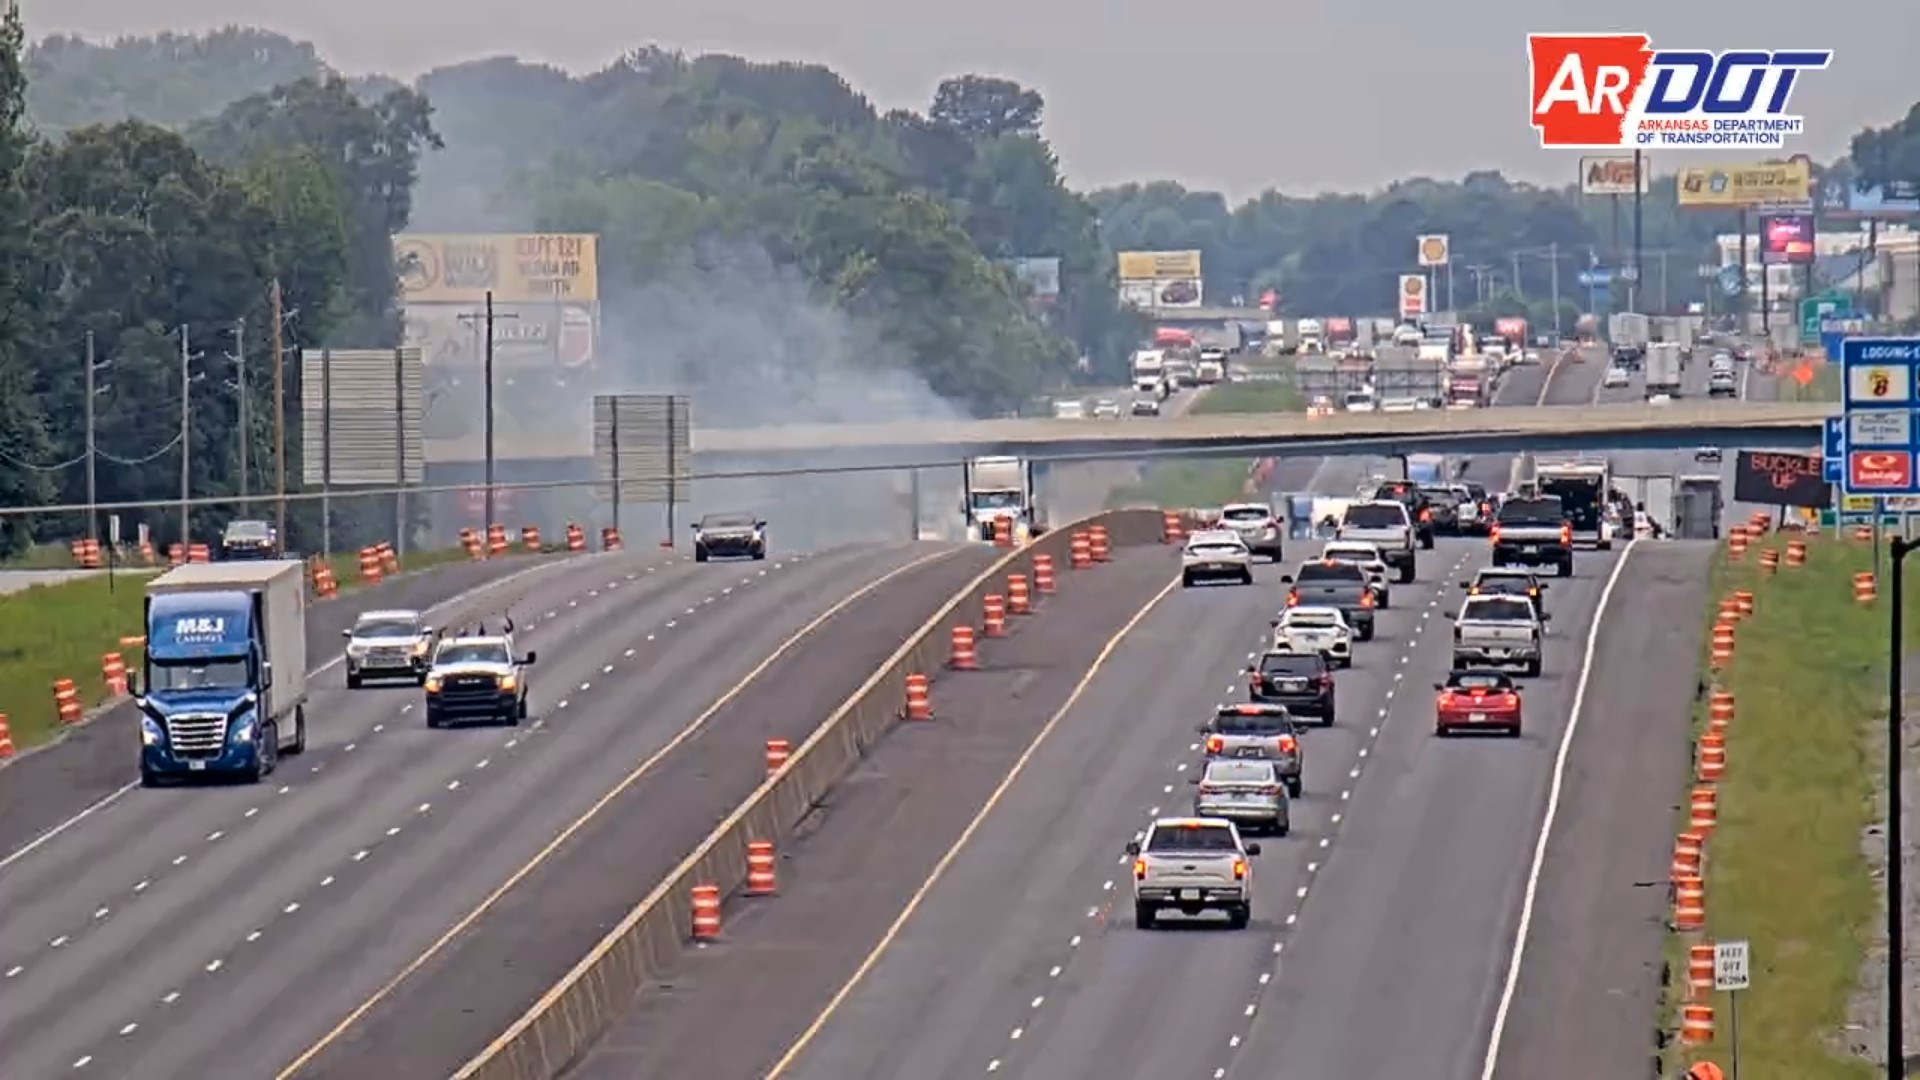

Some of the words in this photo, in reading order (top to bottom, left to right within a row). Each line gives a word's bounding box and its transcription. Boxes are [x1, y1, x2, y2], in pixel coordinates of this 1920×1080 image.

[1751, 453, 1820, 476] BUCKLE
[1771, 470, 1797, 489] UP
[176, 617, 224, 634] M&J
